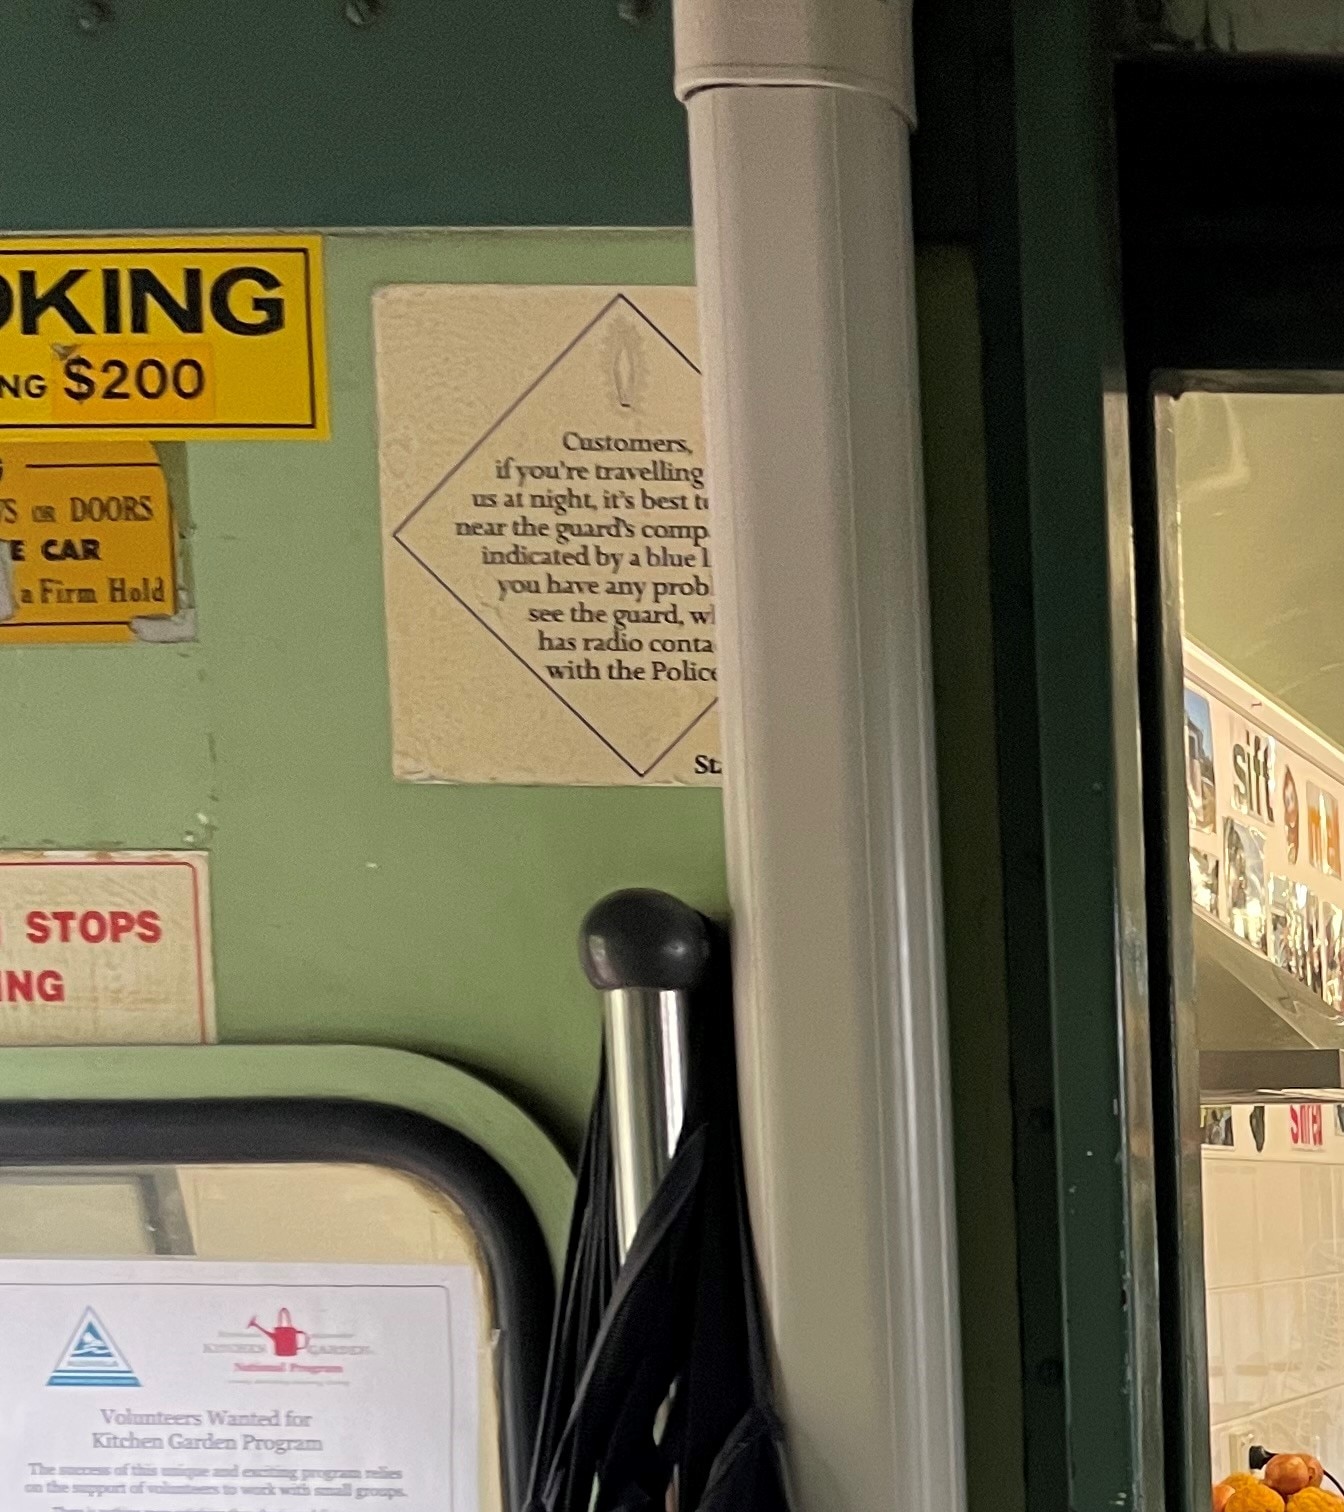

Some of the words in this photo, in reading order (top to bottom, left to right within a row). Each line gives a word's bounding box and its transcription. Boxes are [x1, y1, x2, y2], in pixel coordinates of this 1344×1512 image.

[0, 267, 285, 337] KING
[64, 357, 205, 405] $200
[563, 431, 694, 454] Customers,
[496, 457, 514, 480] if
[515, 461, 589, 487] you're
[596, 460, 704, 489] travelling
[70, 496, 153, 522] DOORS
[472, 493, 497, 507] us
[504, 493, 524, 508] at
[530, 489, 598, 515] night,
[603, 489, 635, 510] it's
[641, 488, 688, 510] best
[455, 522, 508, 536] near
[512, 515, 550, 537] the
[556, 516, 636, 545] guard's
[41, 539, 102, 561] CAR
[482, 543, 591, 566] indicated
[595, 545, 625, 574] by
[629, 550, 641, 567] a
[646, 546, 697, 568] blue
[20, 588, 32, 604] a
[39, 578, 98, 604] Firm
[107, 576, 165, 603] Hold
[498, 578, 541, 601] you
[547, 572, 599, 594] have
[605, 581, 647, 602] any
[529, 606, 564, 622] see
[570, 602, 608, 623] the
[614, 604, 684, 630] guard,
[538, 630, 576, 651] has
[583, 629, 643, 652] radio
[546, 659, 600, 680] with
[608, 660, 646, 681] the
[26, 911, 162, 943] STOPS
[0, 970, 65, 1002] NG
[100, 1408, 202, 1426] Volunteers
[206, 1410, 280, 1427] Wanted
[285, 1410, 313, 1427] for
[92, 1432, 164, 1449] Kitchen
[168, 1433, 237, 1450] Garden
[242, 1434, 323, 1454] Program
